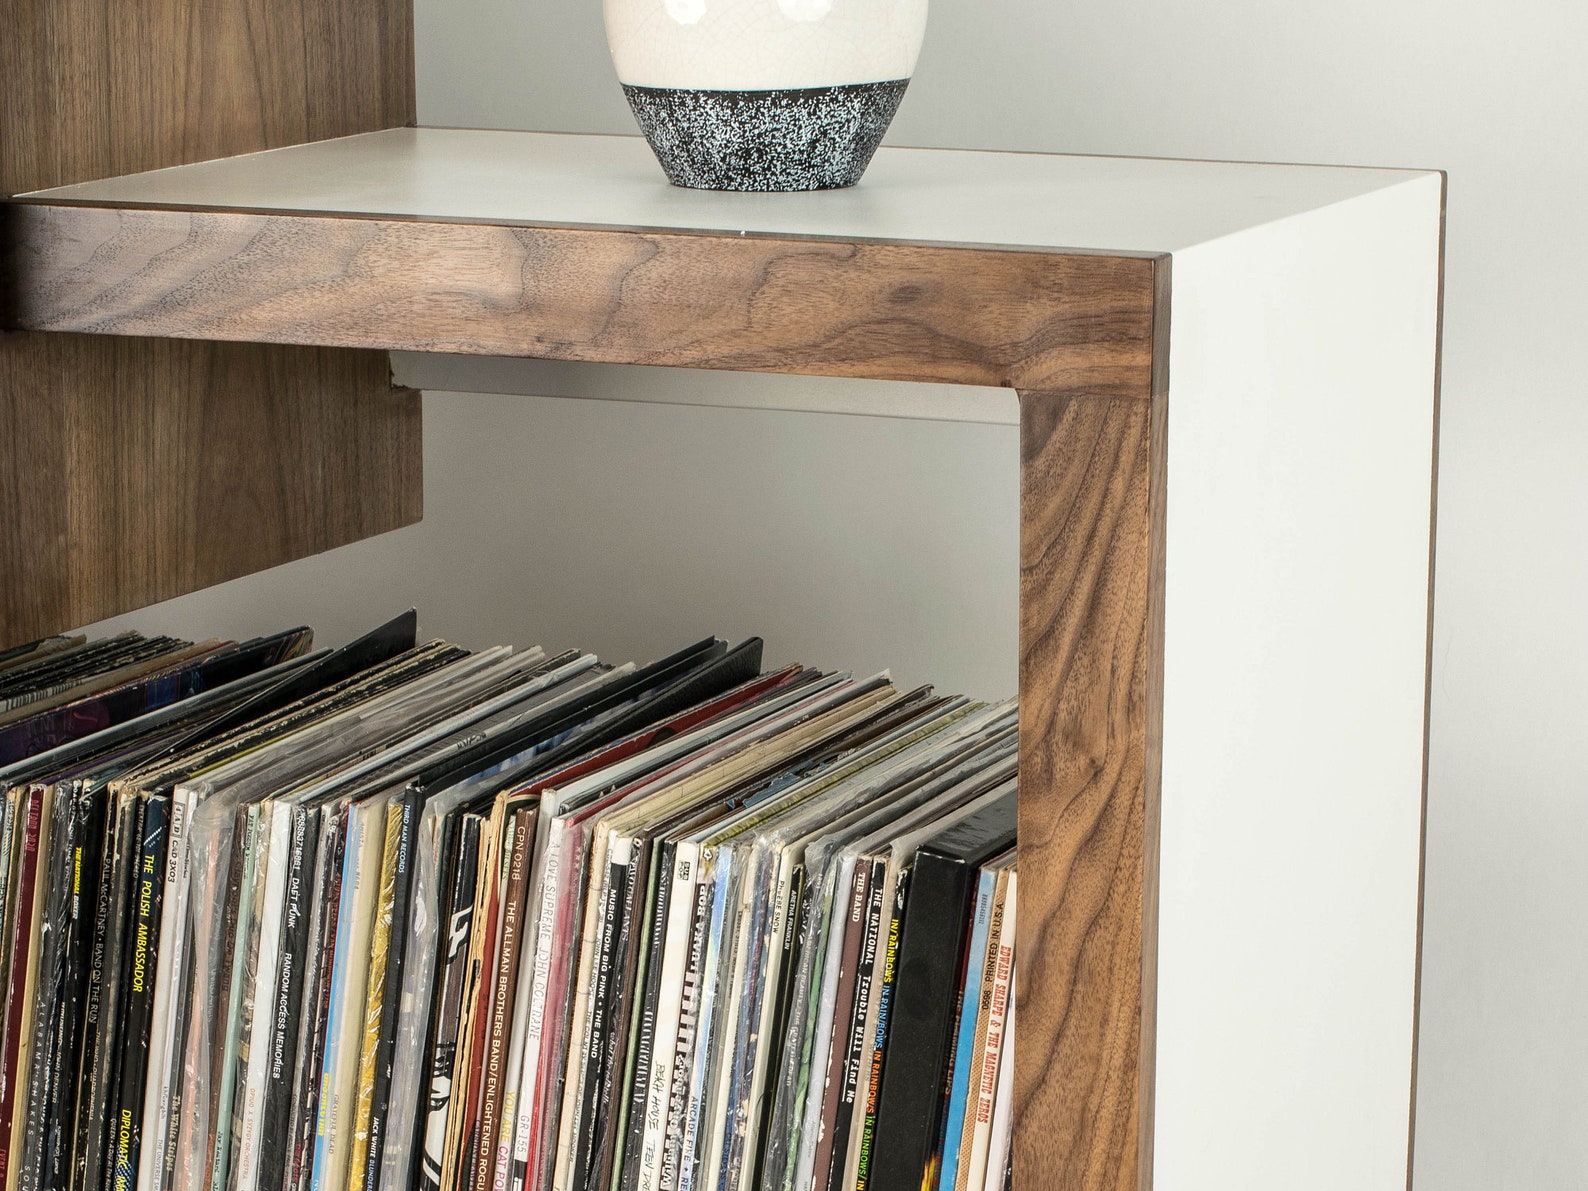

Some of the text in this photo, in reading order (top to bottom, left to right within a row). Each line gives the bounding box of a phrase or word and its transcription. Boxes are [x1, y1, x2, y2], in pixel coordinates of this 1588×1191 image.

[74, 846, 82, 859] THE
[397, 804, 410, 873] THIRD MAN RECORDS
[511, 826, 525, 880] CPN 0218
[72, 860, 81, 894] NATIONAL
[545, 853, 559, 880] LOVE
[70, 894, 79, 919] BOXER
[286, 877, 299, 928] DAFT PUNK
[504, 899, 516, 923] THE
[538, 885, 555, 939] SUPREME
[605, 888, 617, 920] MUSIC
[850, 872, 865, 922] THE BAND
[871, 887, 882, 908] THE
[132, 854, 155, 992] THE POLISH AMBASSADOR
[689, 884, 707, 971] LUAKA BOP
[772, 911, 781, 934] SNOW
[783, 889, 797, 949] ARETHA FRANKLIN
[889, 918, 899, 933] IN/
[88, 858, 111, 1023] PAUL McCARTNEY BAND ON THE RUN
[499, 925, 513, 973] ALLMAN
[602, 923, 613, 952] FROM
[863, 912, 879, 964] NATIONAL
[534, 946, 549, 979] JOHN
[600, 954, 609, 972] BIG
[882, 934, 897, 982] RAINBOWS
[985, 929, 1000, 982] PRINTED IN
[995, 944, 1012, 980] EDWARD
[596, 974, 607, 998] PINK
[855, 975, 871, 1021] Trouble
[880, 984, 890, 996] IN
[990, 983, 1007, 1016] SHARPE
[271, 952, 292, 1078] RANDOM ACCESS MEMORIES
[492, 976, 508, 1037] BROTHERS
[527, 981, 545, 1040] COLTRANE
[593, 1009, 603, 1028] THE
[874, 997, 888, 1048] RAIN/BOWS
[590, 1030, 600, 1058] BAND
[851, 1026, 864, 1052] Will
[872, 1050, 881, 1061] IN
[986, 1031, 1000, 1049] THE
[50, 1072, 60, 1103] DENVER
[650, 1061, 667, 1092] BEACH
[847, 1058, 860, 1084] Find
[865, 1062, 880, 1113] RAINBOW/S
[944, 1068, 954, 1095] LIPS
[980, 1052, 997, 1094] MAGNETIC
[27, 1080, 39, 1135] SHAKES
[479, 1039, 501, 1156] BAND/ENLIGHTENED
[502, 1090, 515, 1117] YOU
[844, 1088, 856, 1103] Me
[976, 1096, 991, 1123] ZEROS
[108, 1117, 117, 1139] QUEEN
[327, 1094, 339, 1154] GRATEFUL DEAD
[370, 1116, 379, 1133] JACK
[646, 1096, 663, 1130] HOUSE
[685, 1096, 698, 1136] ARCADE
[863, 1115, 873, 1126] IN
[116, 1108, 132, 1170] DIPLOMATIC
[165, 1095, 180, 1171] The White Stripes
[368, 1135, 377, 1158] WHITE
[499, 1118, 512, 1142] ARE
[515, 1114, 529, 1153] GR-155
[241, 1142, 251, 1180] ORCHESTRA
[495, 1145, 509, 1169] CAT
[641, 1139, 658, 1169] TEEN
[856, 1128, 871, 1178] RAINBOWS/
[855, 1180, 864, 1191] IN
